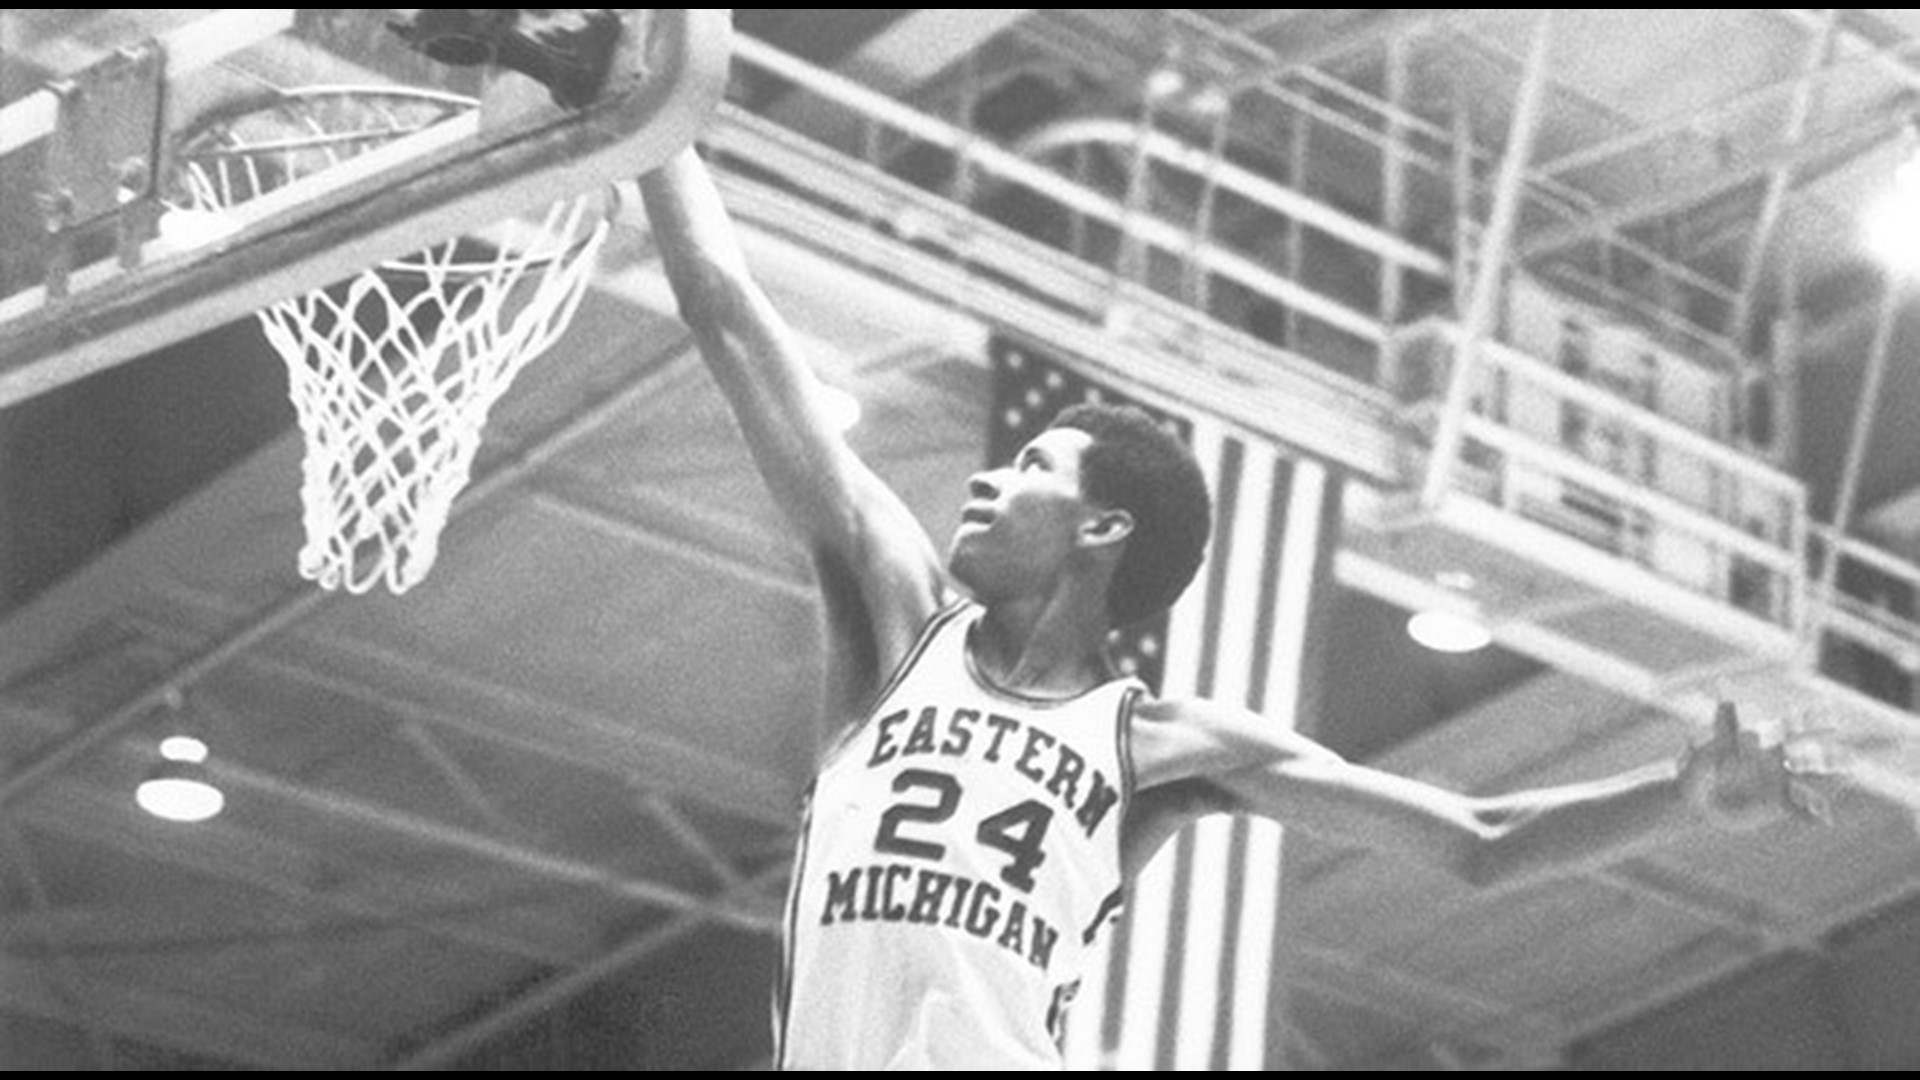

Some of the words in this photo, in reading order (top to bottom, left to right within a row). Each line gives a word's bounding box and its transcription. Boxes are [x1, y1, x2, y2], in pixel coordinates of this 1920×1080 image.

[867, 706, 1118, 838] EASTERN
[873, 768, 1054, 893] 24
[820, 864, 1059, 970] MICHIGAN
